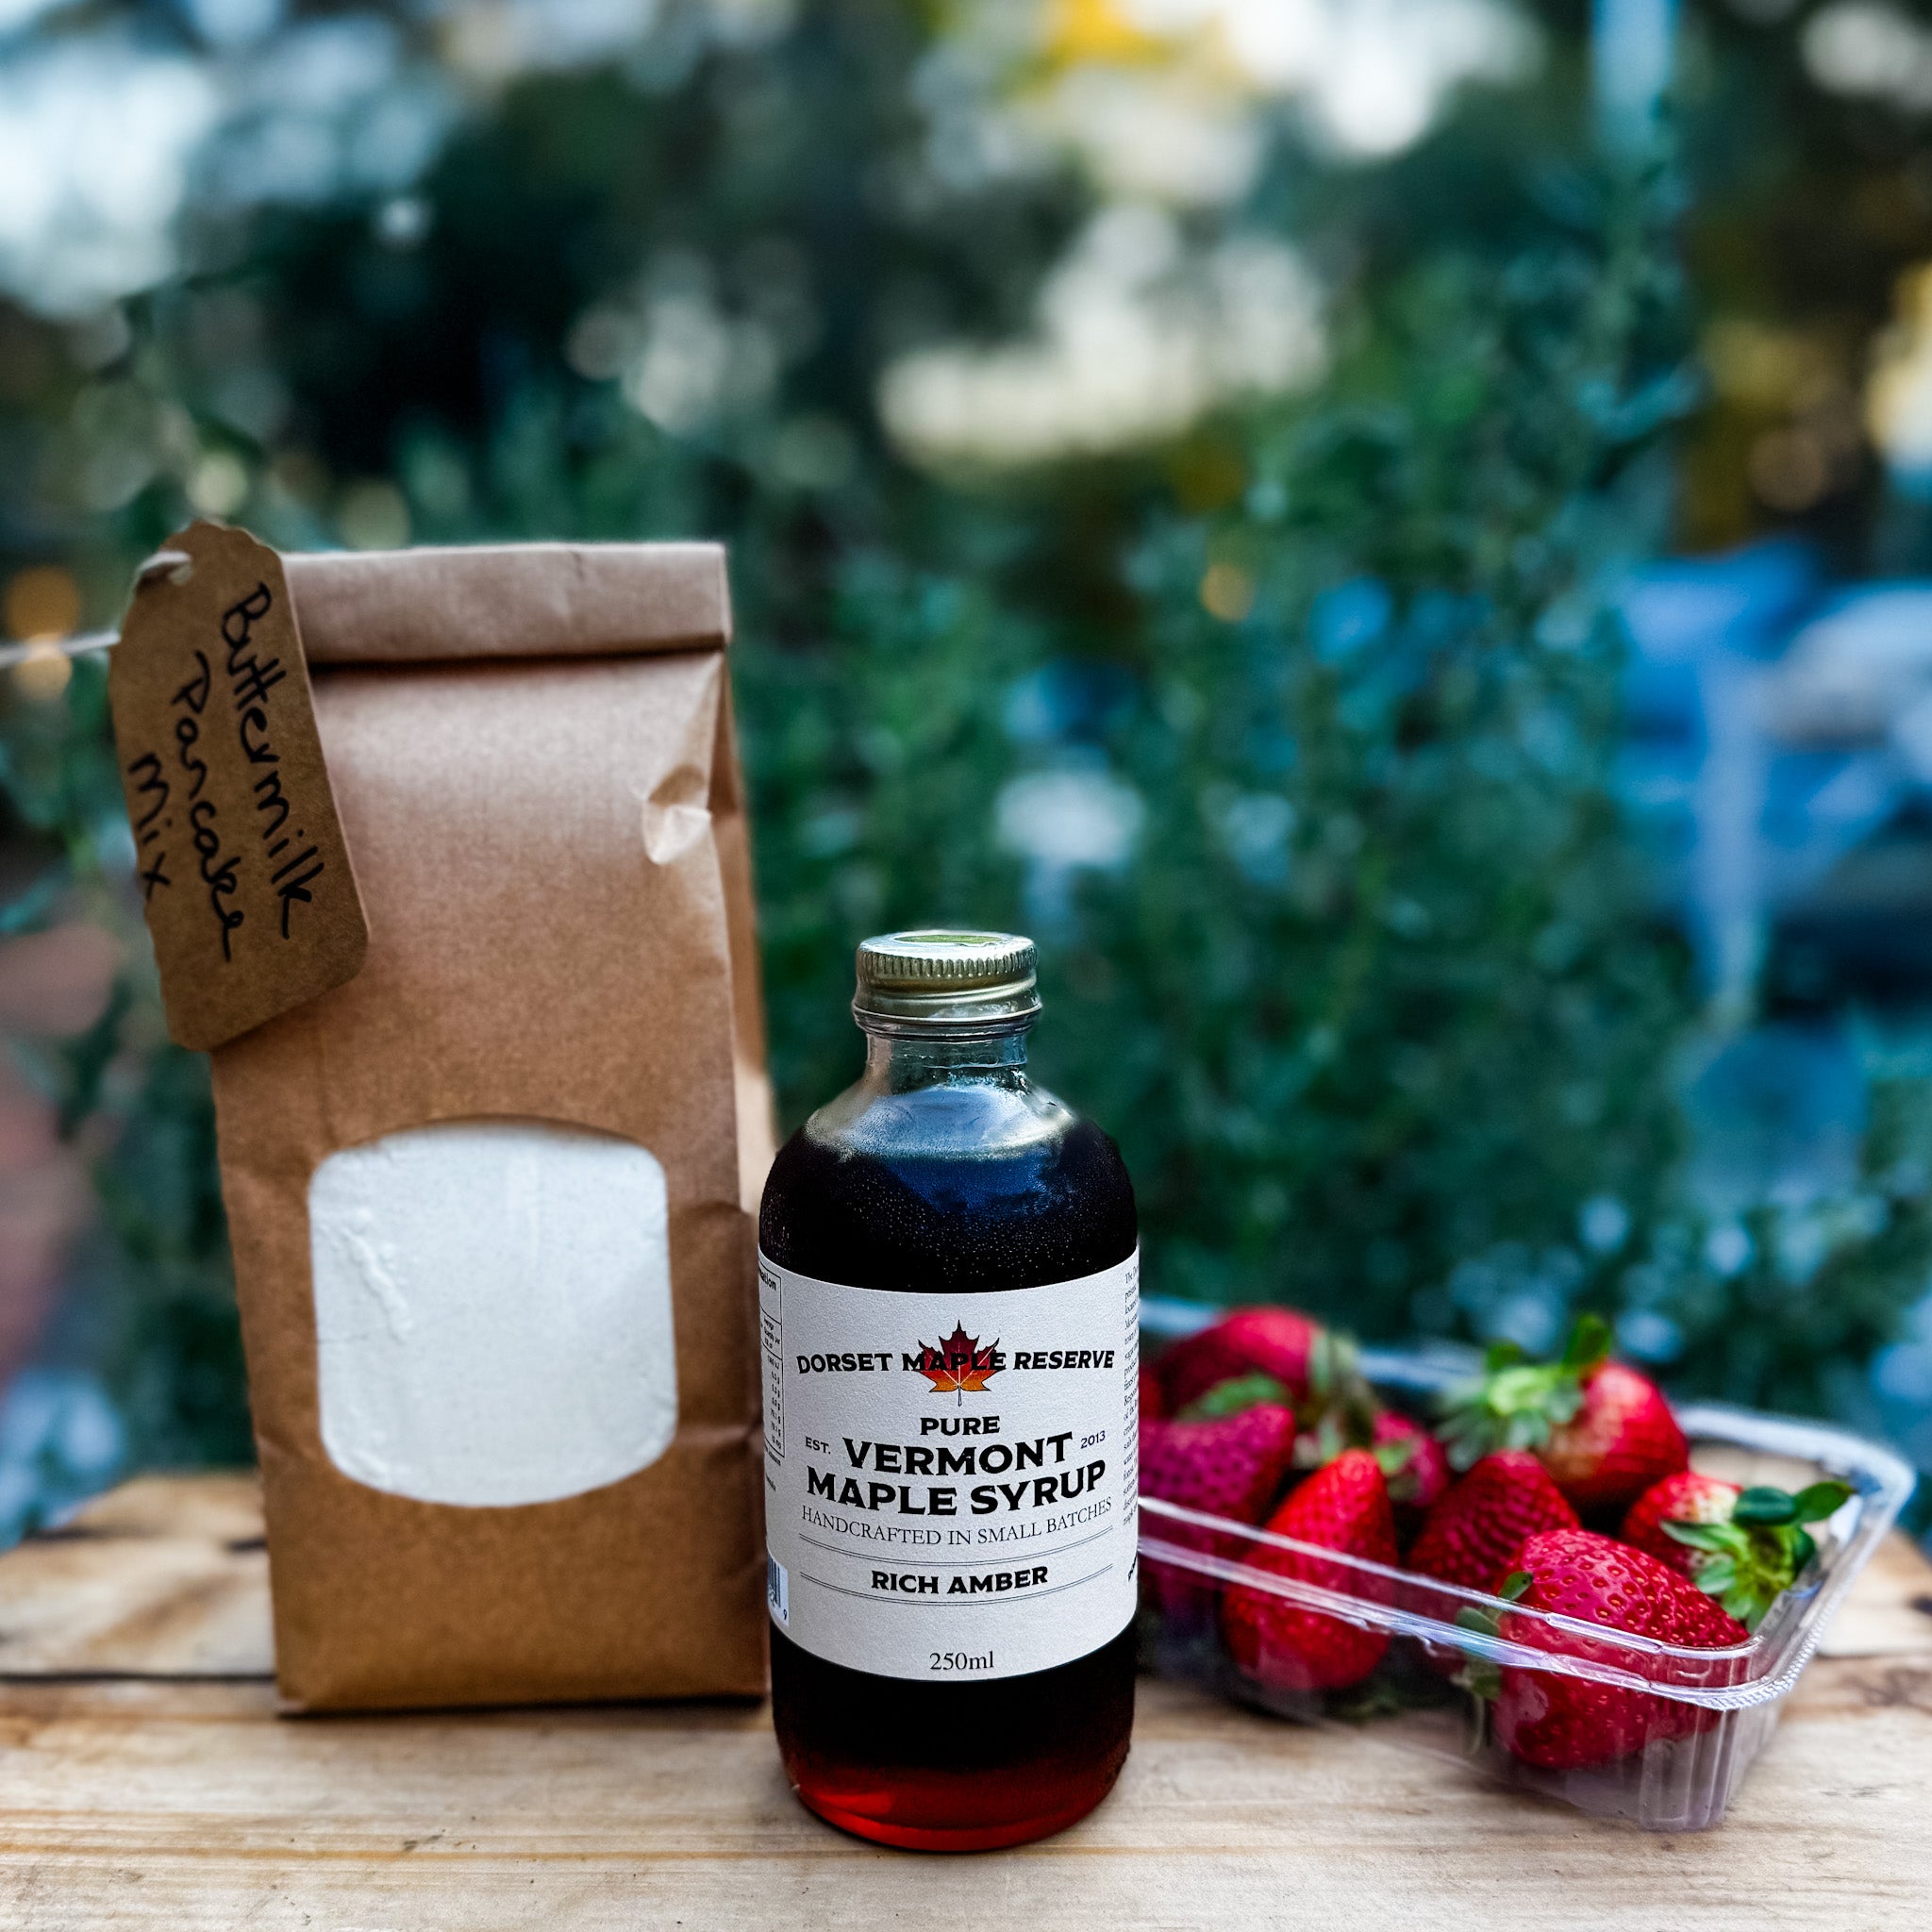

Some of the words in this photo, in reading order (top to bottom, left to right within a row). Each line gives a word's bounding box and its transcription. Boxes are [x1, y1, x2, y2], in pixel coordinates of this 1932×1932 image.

[222, 582, 325, 941] Buttermilk
[128, 752, 173, 902] Mix
[170, 649, 244, 962] Pancake
[796, 1353, 893, 1374] DORSET
[902, 1352, 1007, 1372] MAPLE
[1013, 1350, 1115, 1371] RESERVE
[920, 1415, 1000, 1436] PURE
[805, 1436, 831, 1455] EST.
[842, 1431, 1073, 1475] VERMONT
[1080, 1430, 1106, 1449] 2013
[807, 1465, 958, 1515] MAPLE
[971, 1459, 1106, 1515] SYRUP
[802, 1505, 941, 1545] HANDCRAFTED
[948, 1530, 971, 1545] IN
[977, 1522, 1041, 1544] SMALL
[1047, 1496, 1111, 1533] BATCHES
[871, 1570, 939, 1594] RICH
[947, 1566, 1048, 1594] AMBER
[929, 1651, 993, 1671] 250ml
